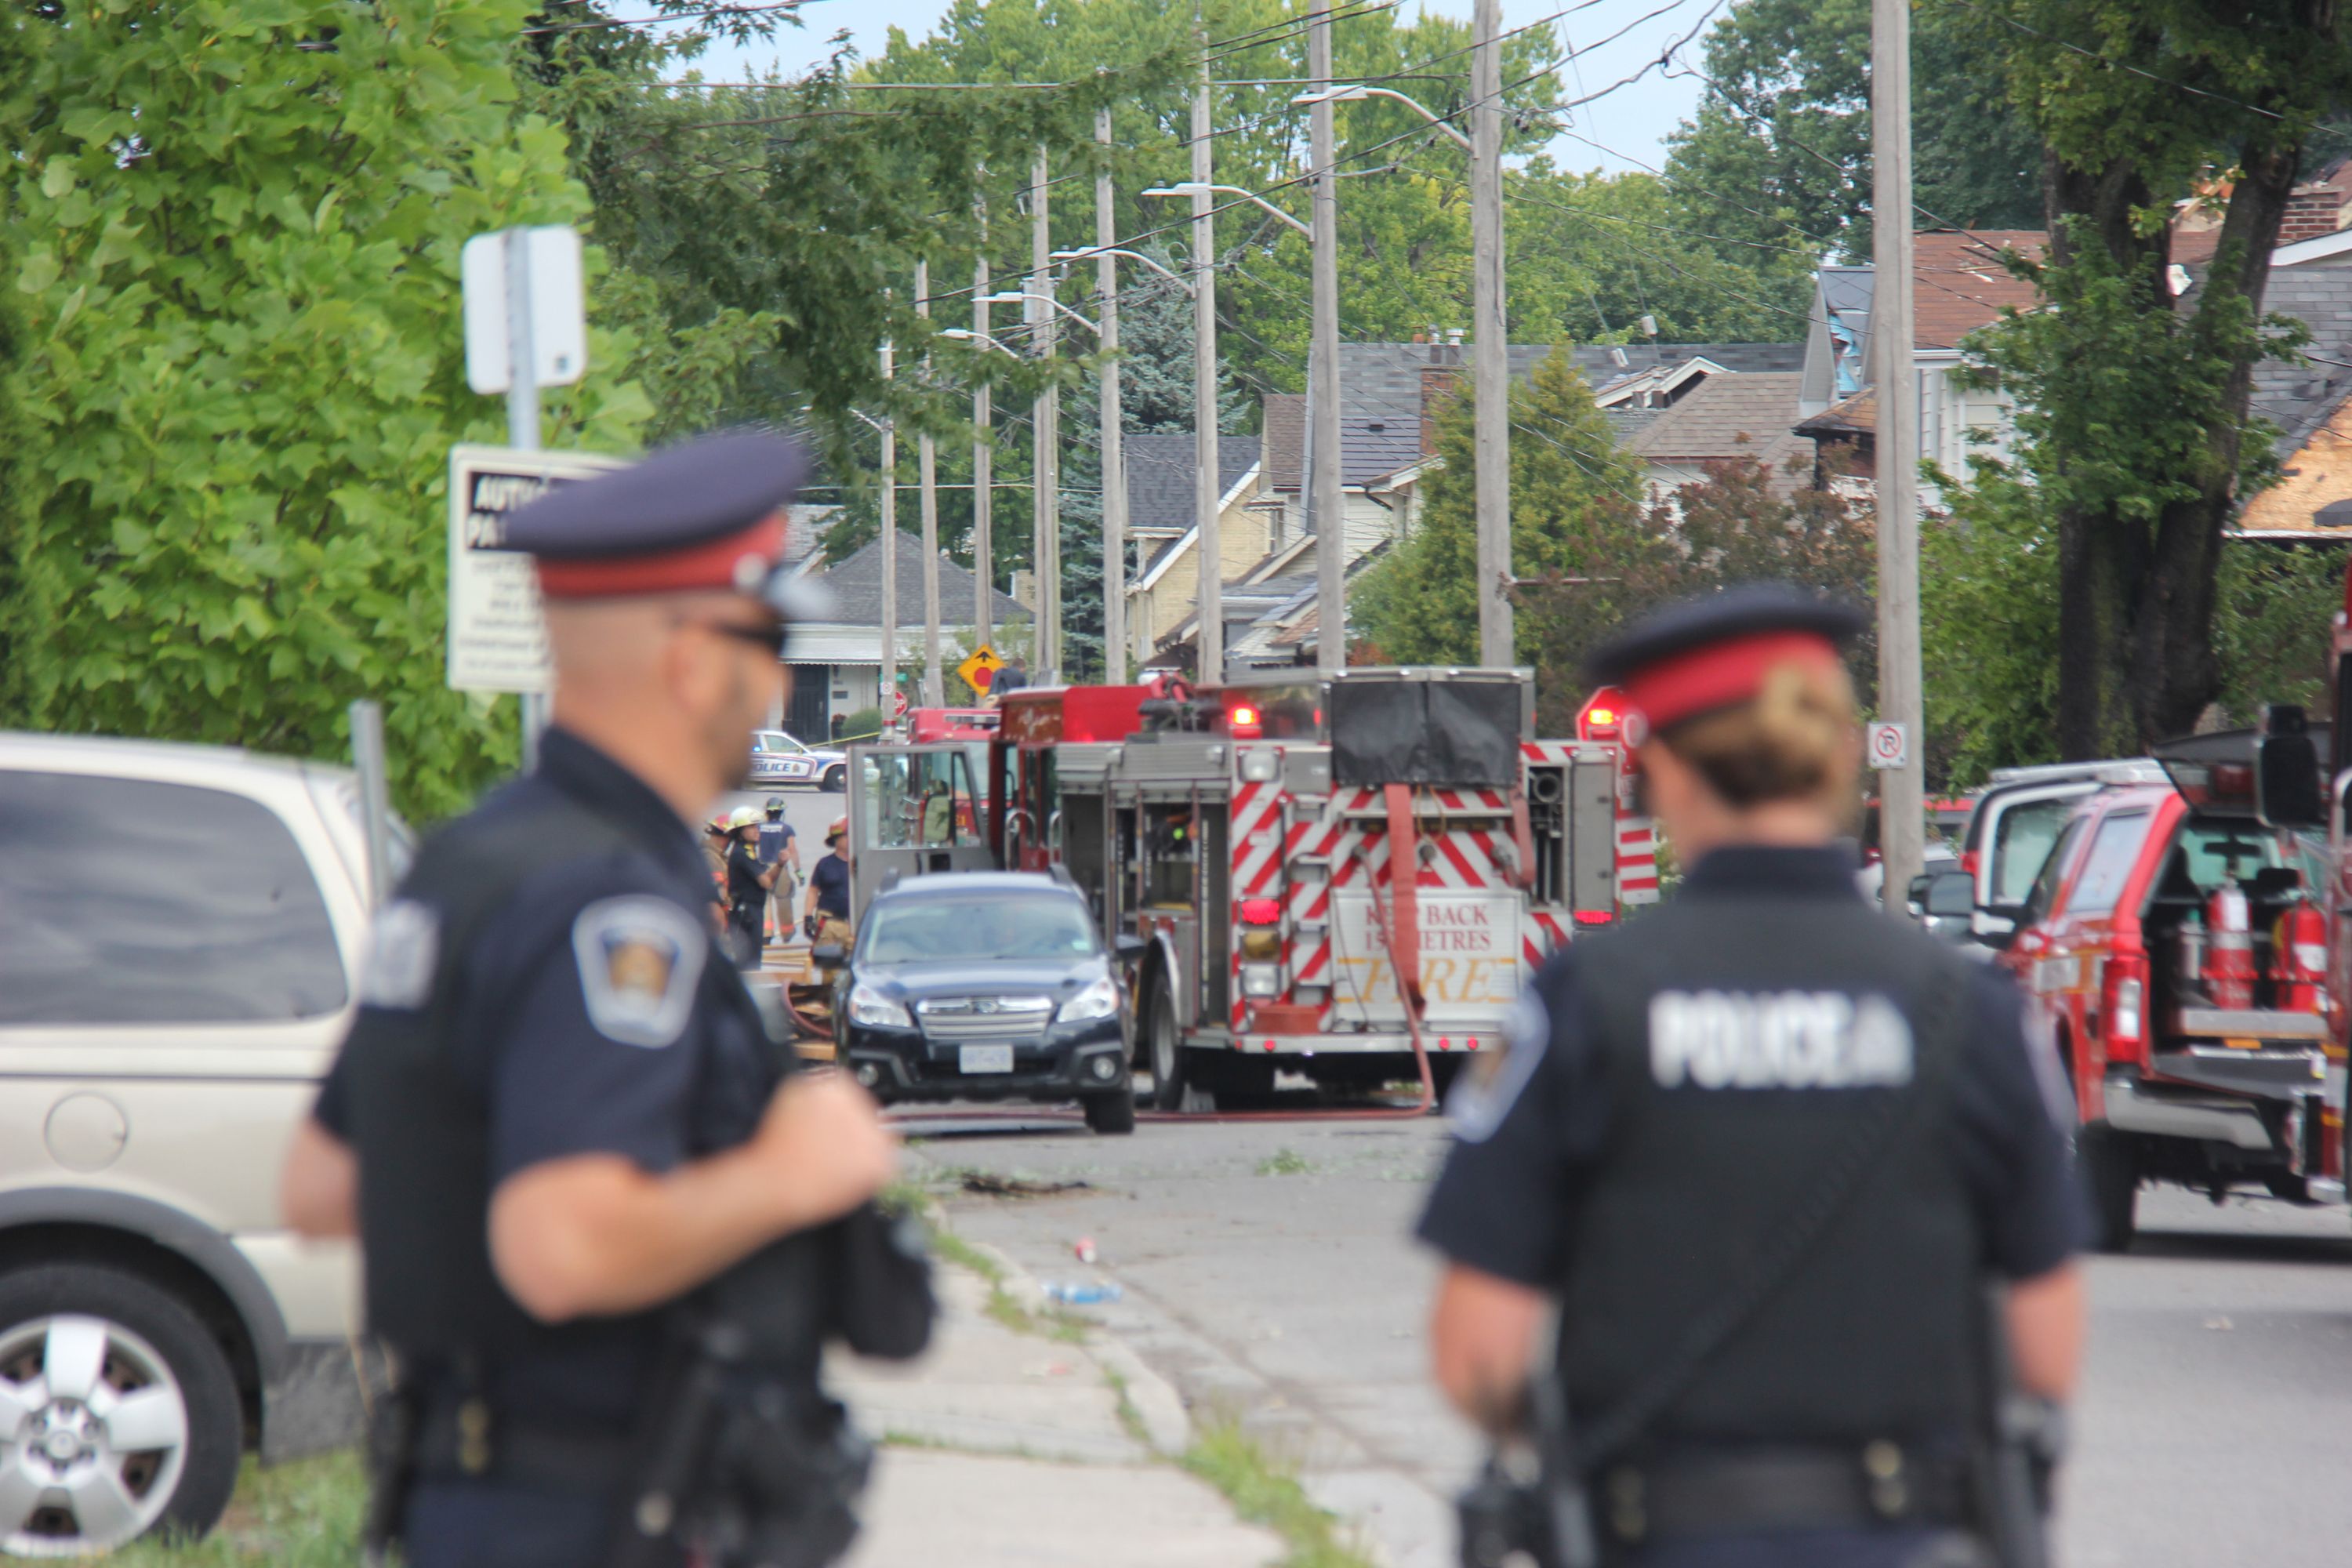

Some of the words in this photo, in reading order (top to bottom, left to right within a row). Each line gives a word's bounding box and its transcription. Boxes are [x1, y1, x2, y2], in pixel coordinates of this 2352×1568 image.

[753, 762, 792, 772] OLICE
[1366, 906, 1419, 926] KE
[1427, 906, 1489, 926] BACK
[1416, 930, 1491, 952] ETRES
[1360, 957, 1498, 1004] FRE
